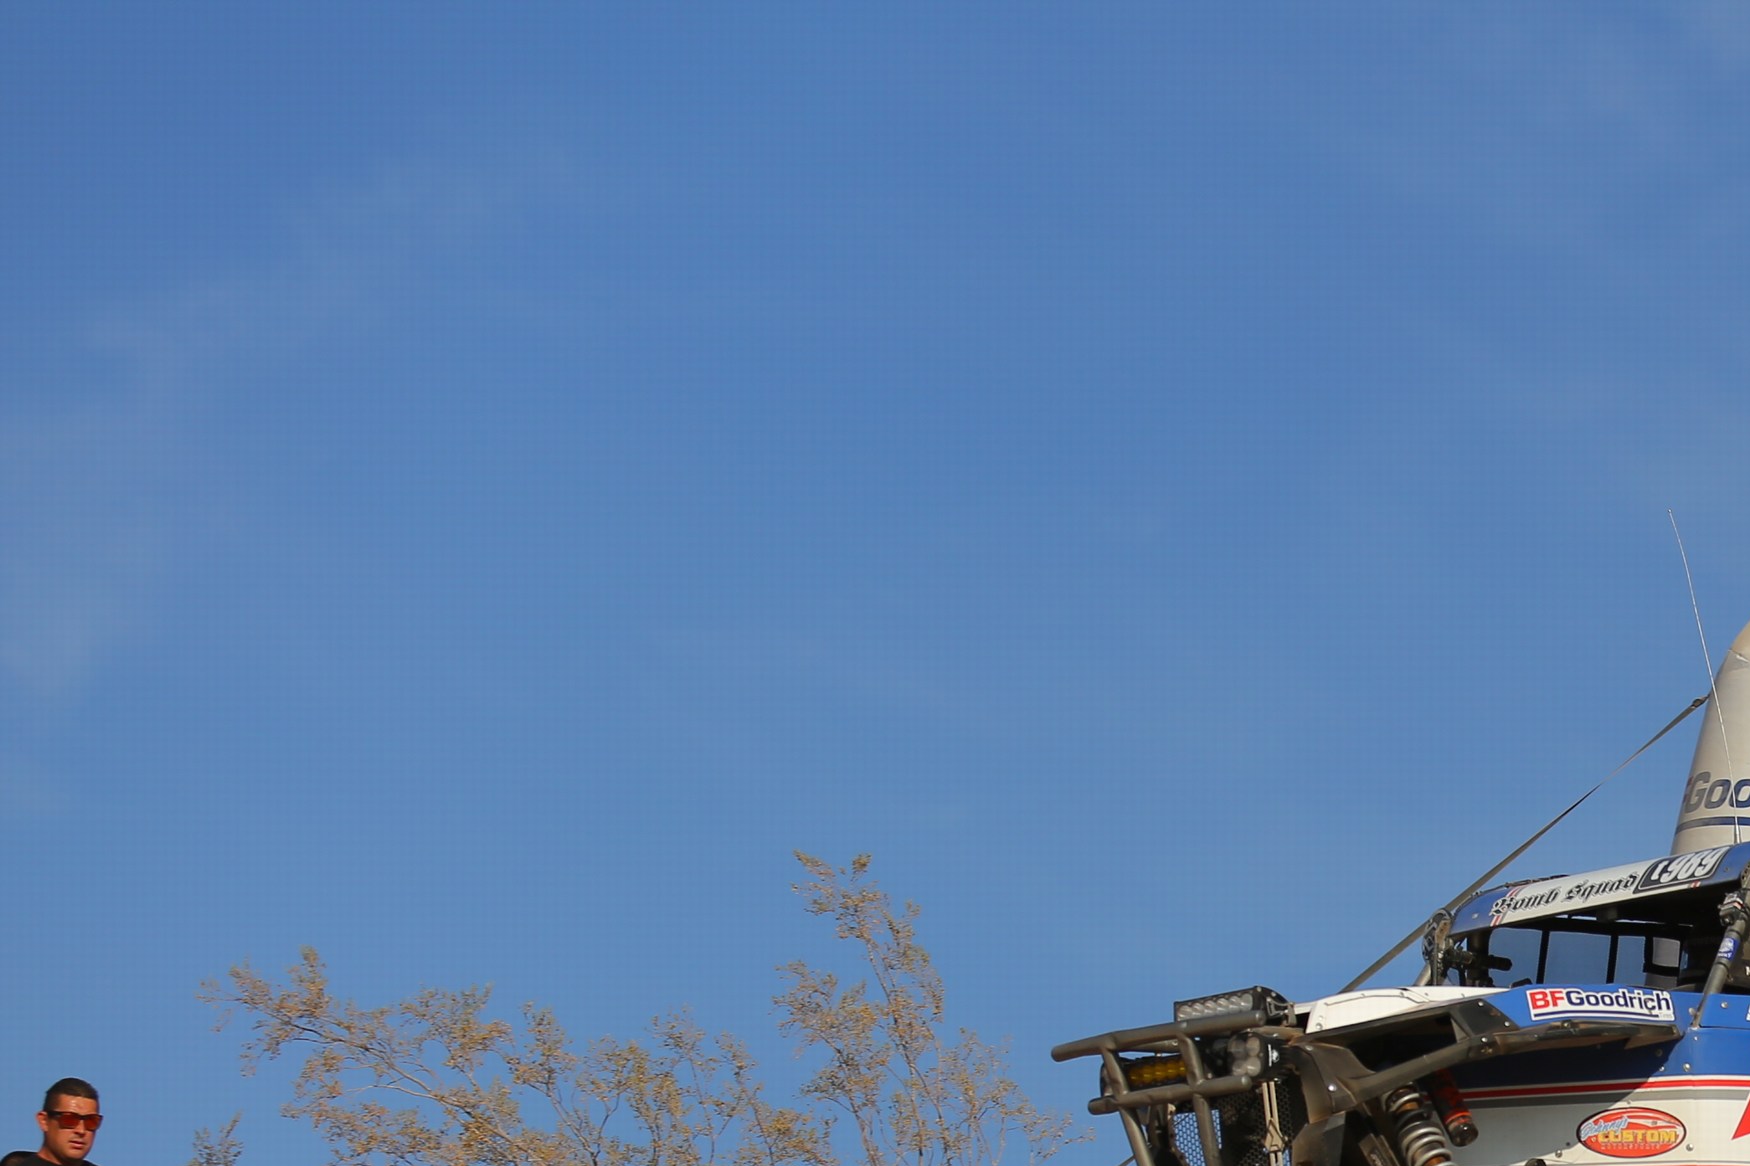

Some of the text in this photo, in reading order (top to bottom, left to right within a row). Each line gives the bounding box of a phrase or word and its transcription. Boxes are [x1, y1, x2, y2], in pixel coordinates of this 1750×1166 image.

[1491, 847, 1731, 916] Bomb Squad 1989
[1528, 989, 1672, 1011] BFGoodrich
[1598, 1130, 1678, 1144] CUSTOM
